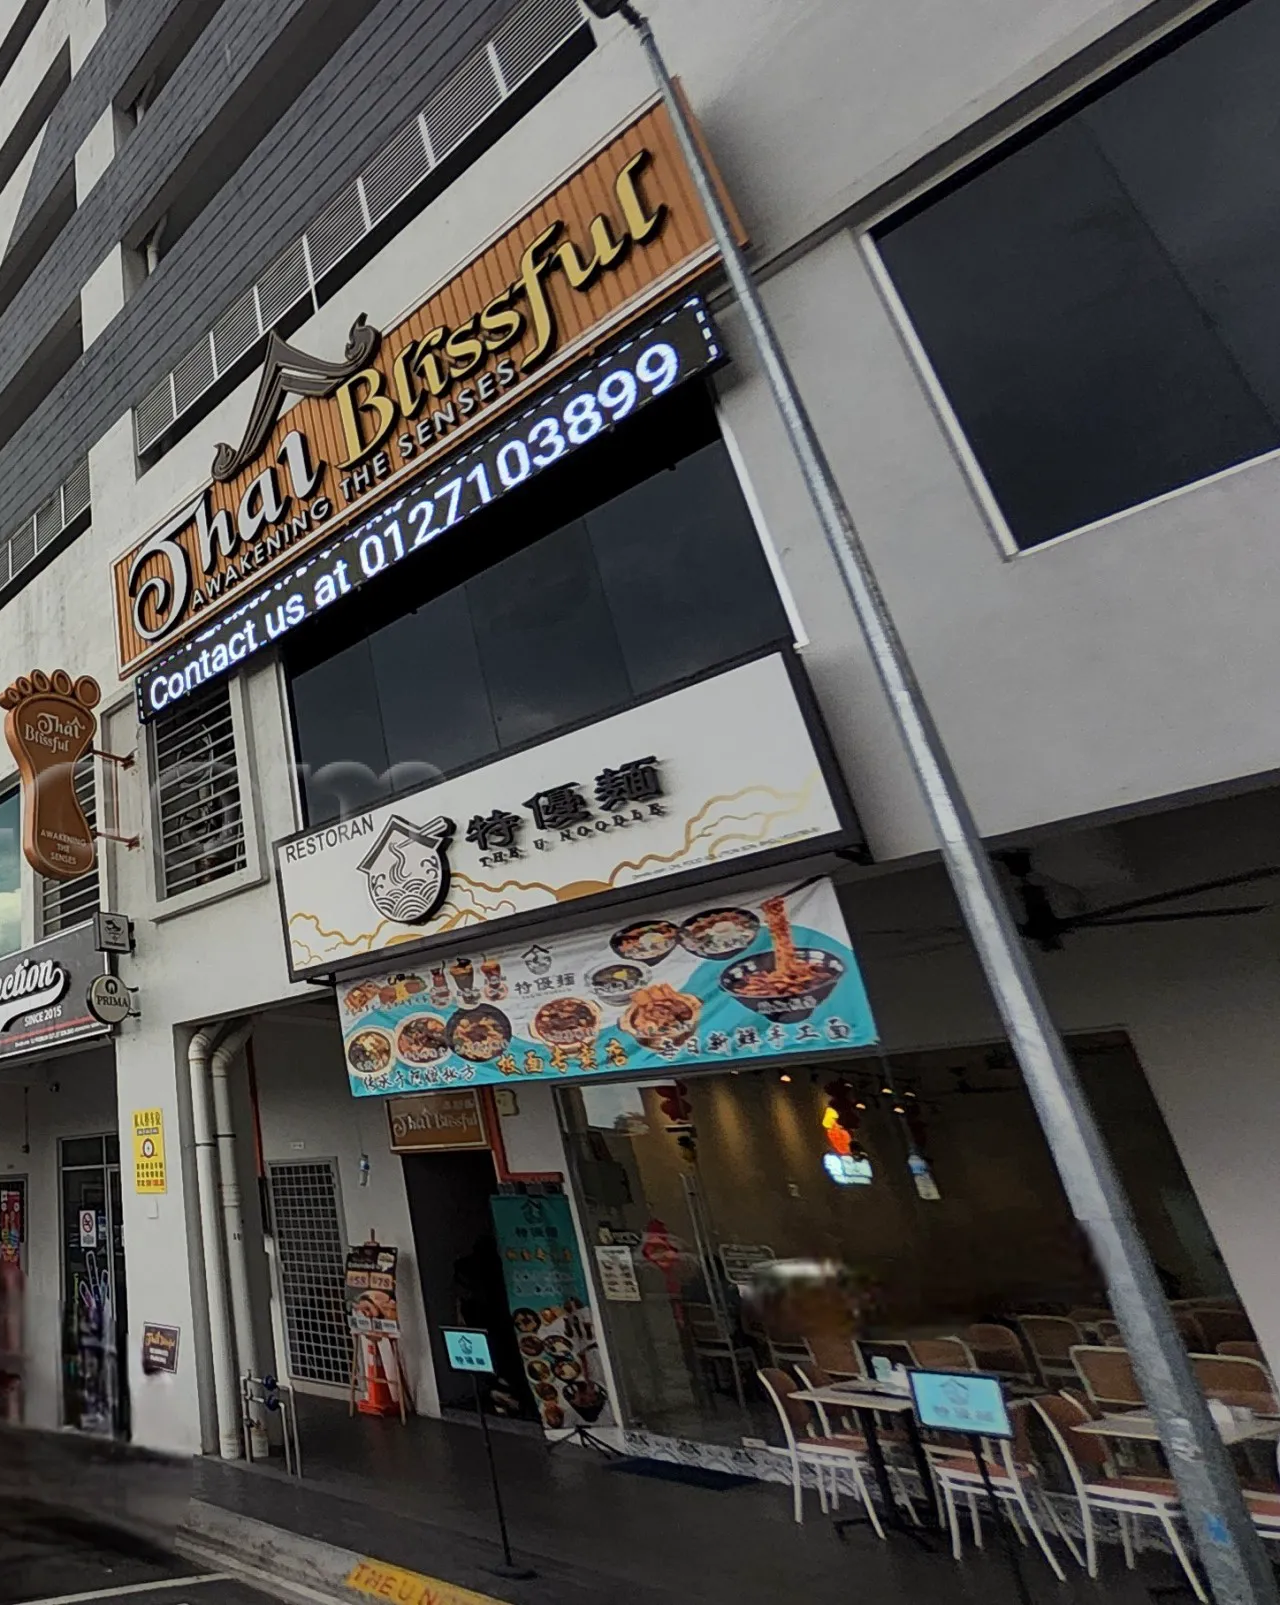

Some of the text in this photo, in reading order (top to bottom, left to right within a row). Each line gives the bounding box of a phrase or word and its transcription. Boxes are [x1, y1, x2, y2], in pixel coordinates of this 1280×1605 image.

[128, 150, 668, 642] Thai Blissful
[190, 359, 516, 612] AWAKENING THE SENSES
[149, 342, 680, 711] Contact us at 0127103899
[24, 712, 84, 753] Thai Blissful
[39, 828, 88, 848] AWAKENING
[56, 842, 71, 853] THE
[285, 814, 375, 863] RESTORAN
[478, 846, 523, 868] THE
[559, 802, 666, 843] NOODLE
[50, 851, 77, 866] SENSES
[24, 1004, 63, 1027] SINCE 2015
[96, 995, 129, 1008] PRIMA
